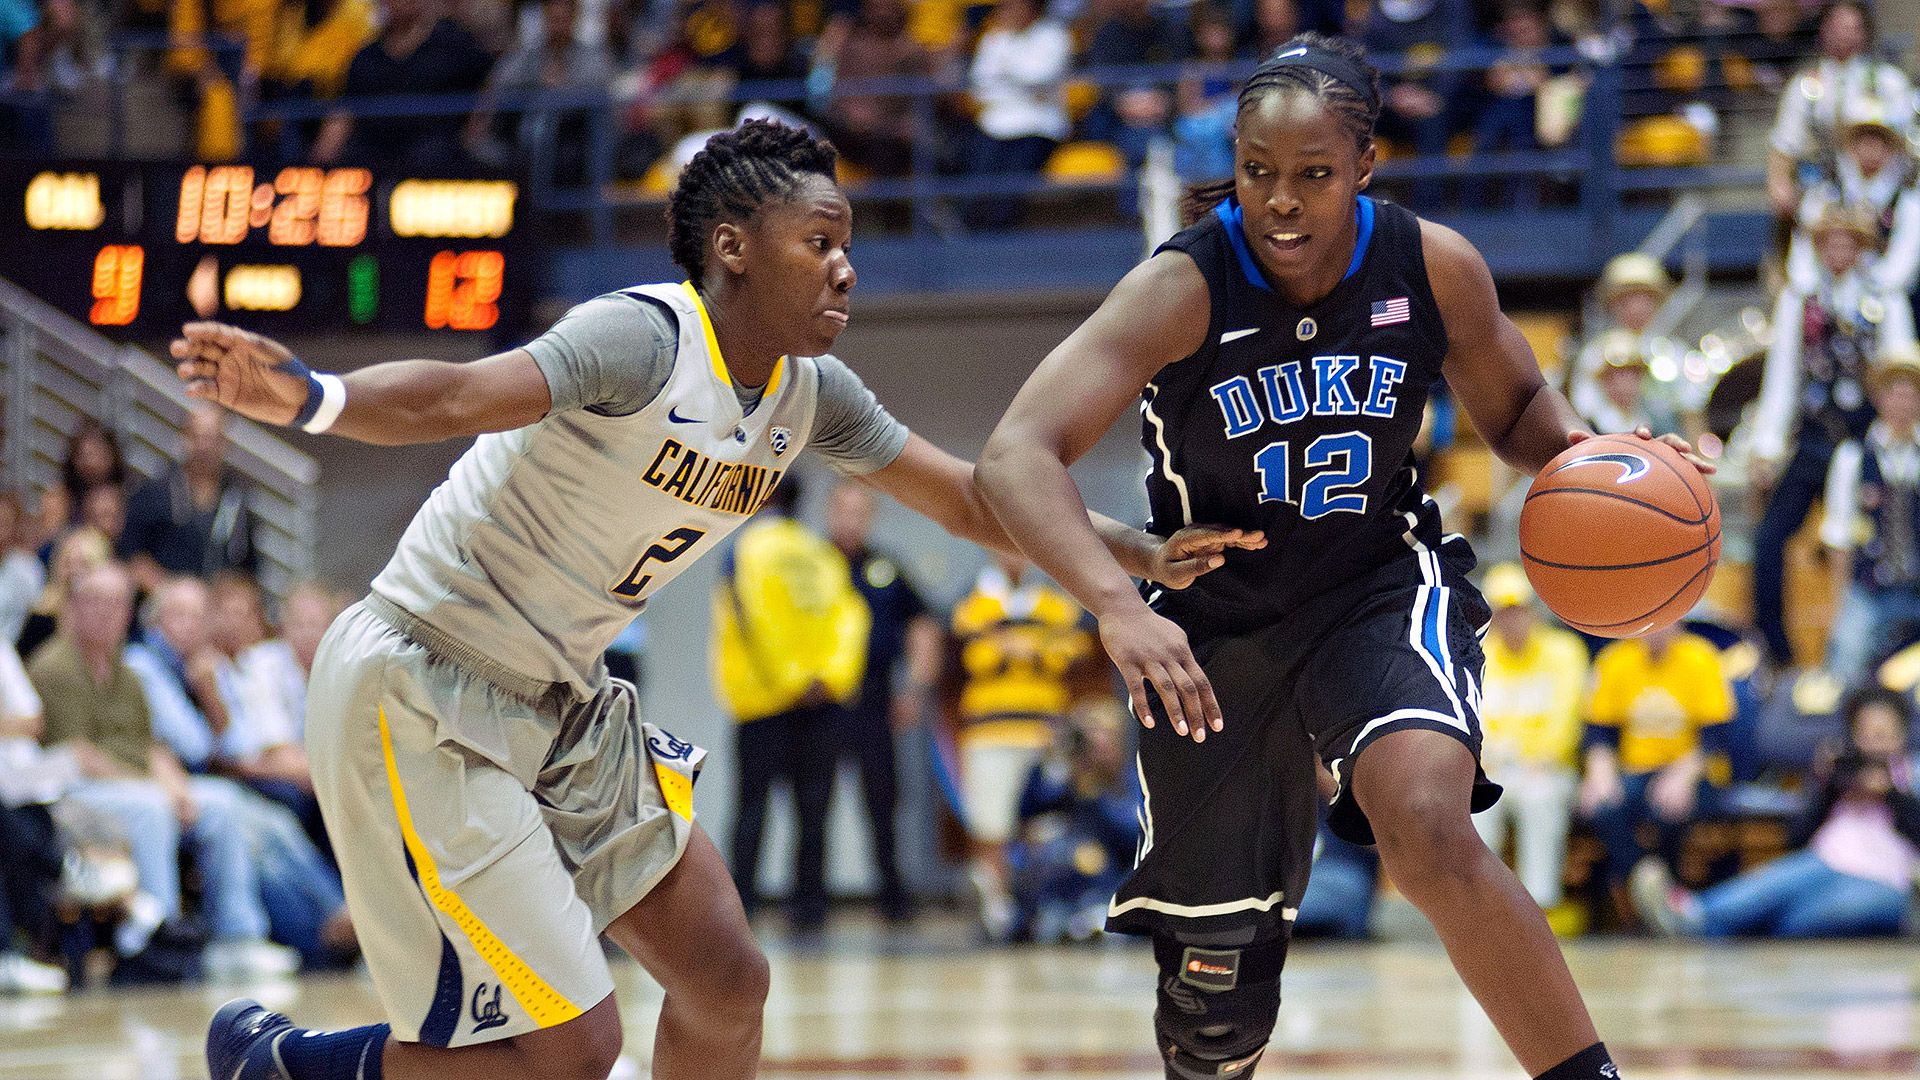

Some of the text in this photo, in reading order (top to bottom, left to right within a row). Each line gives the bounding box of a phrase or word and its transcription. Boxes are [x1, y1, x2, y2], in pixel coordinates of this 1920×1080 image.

[176, 165, 373, 247] 10:26
[425, 250, 505, 331] 12
[1209, 355, 1408, 440] DUKE
[640, 437, 783, 516] CALIFORNIA
[1253, 430, 1372, 520] 12
[608, 525, 709, 599] 2
[471, 982, 509, 1034] Cal
